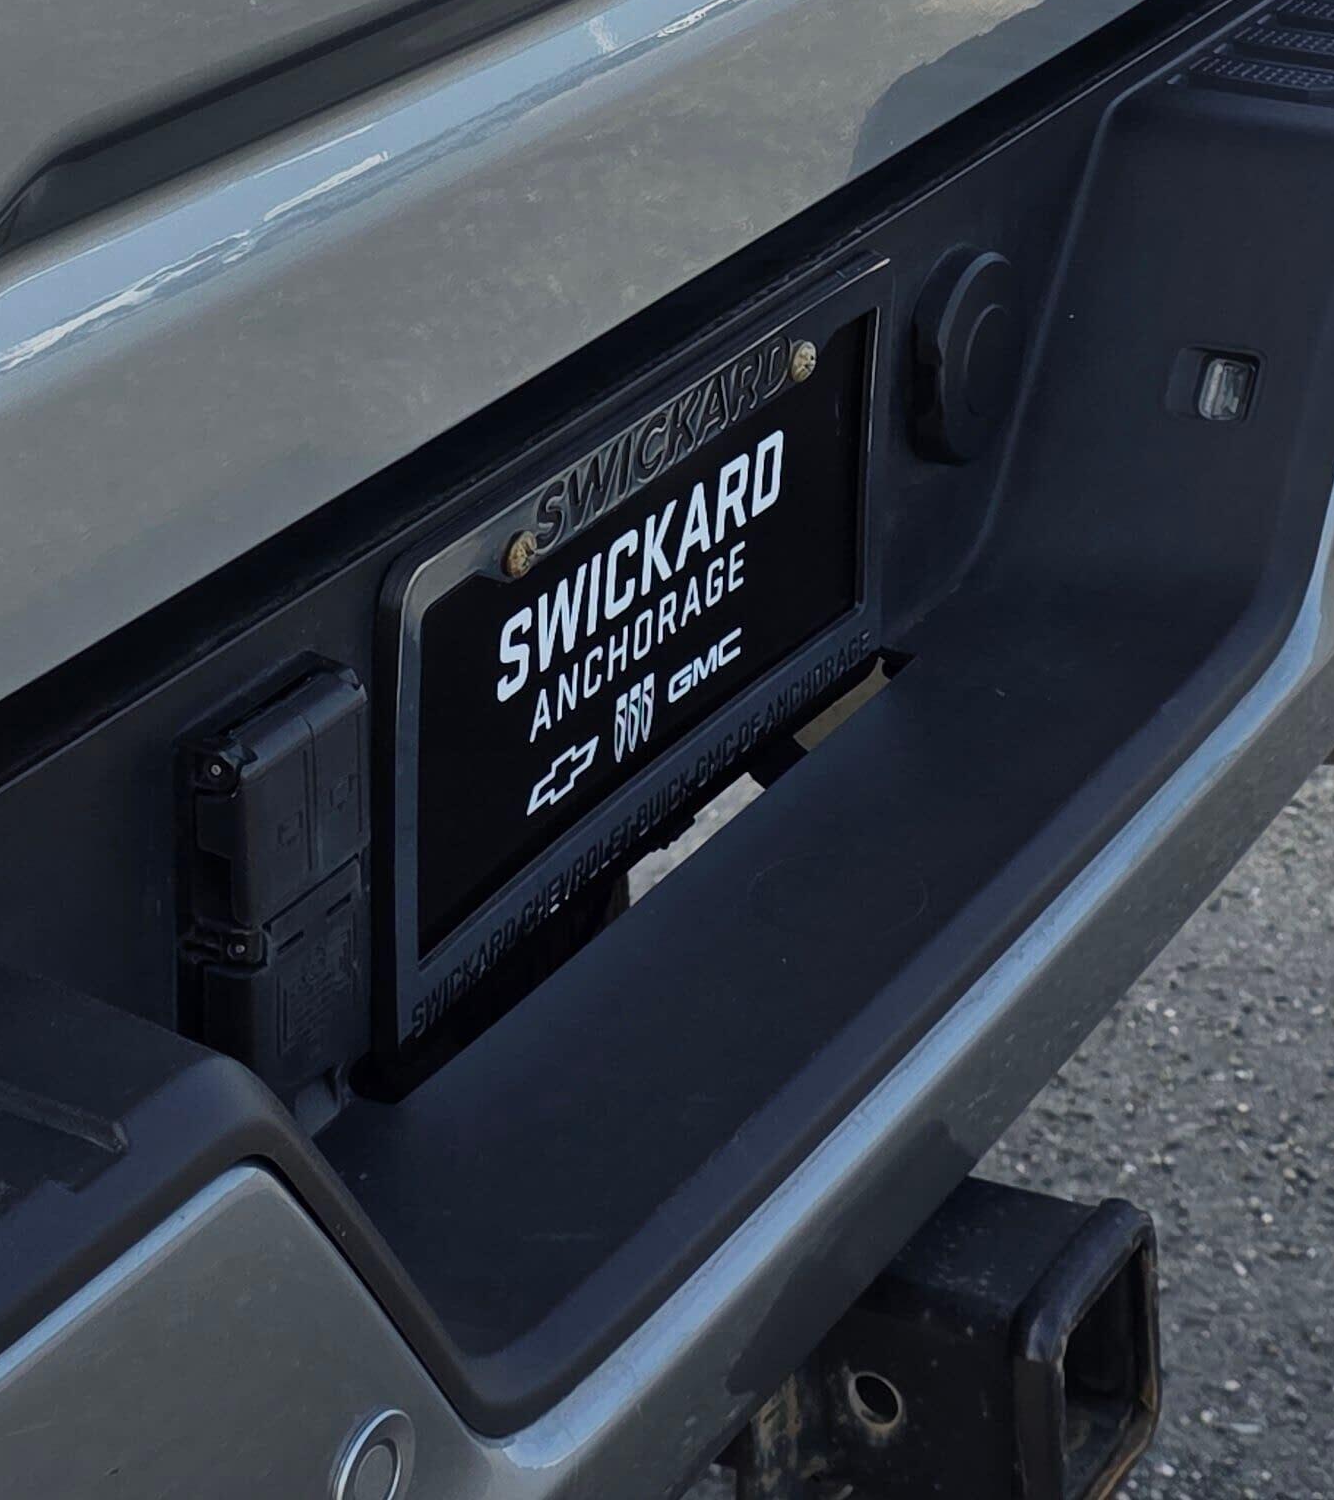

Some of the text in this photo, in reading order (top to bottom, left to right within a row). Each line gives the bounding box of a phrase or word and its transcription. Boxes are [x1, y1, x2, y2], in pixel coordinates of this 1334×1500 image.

[534, 334, 793, 553] SWICKARD
[497, 429, 784, 703] SWICKARD
[530, 541, 746, 743] ANCHORAGE
[668, 627, 742, 704] GMC
[411, 918, 517, 1039] SWICKARD
[766, 628, 871, 733] ANCHORAGE
